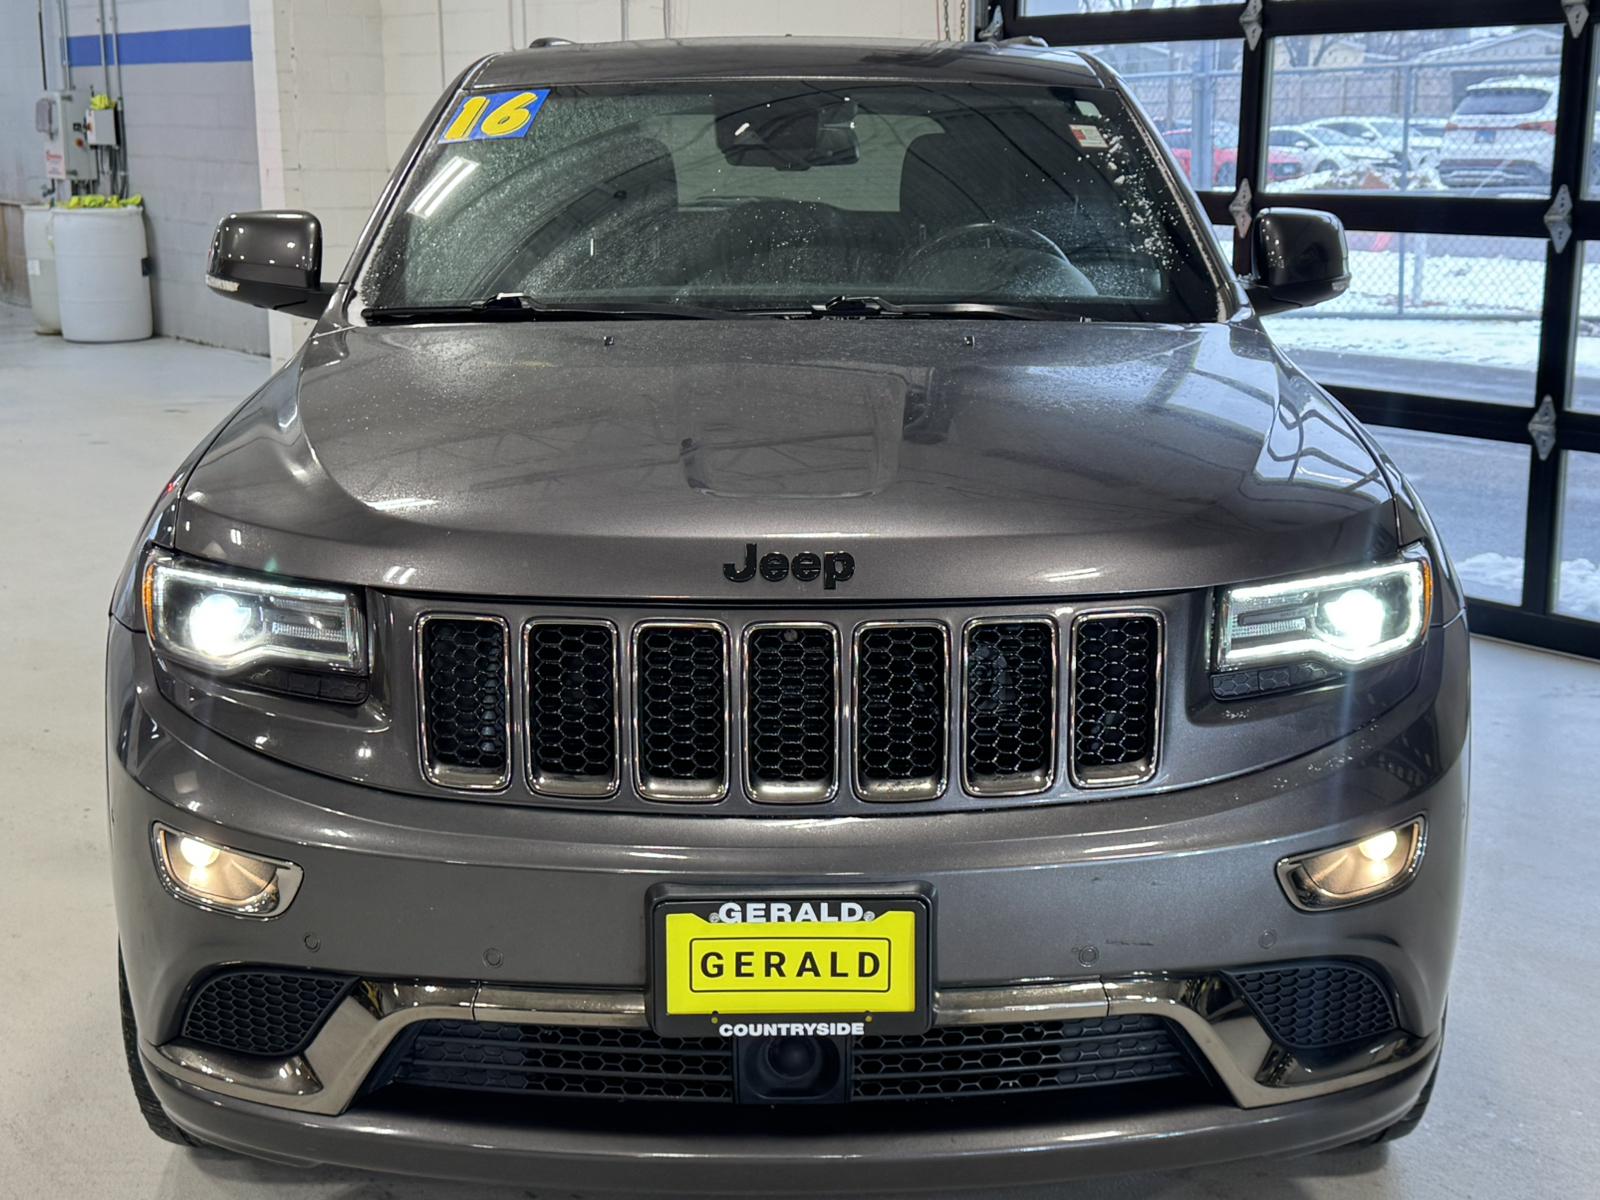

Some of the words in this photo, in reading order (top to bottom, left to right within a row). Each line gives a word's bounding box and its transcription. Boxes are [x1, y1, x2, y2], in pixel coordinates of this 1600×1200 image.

[444, 92, 538, 140] 16
[723, 543, 855, 589] Jeep
[718, 903, 864, 923] GERALD
[700, 951, 880, 978] GERALD
[719, 1022, 865, 1036] COUNTRYSIDE
